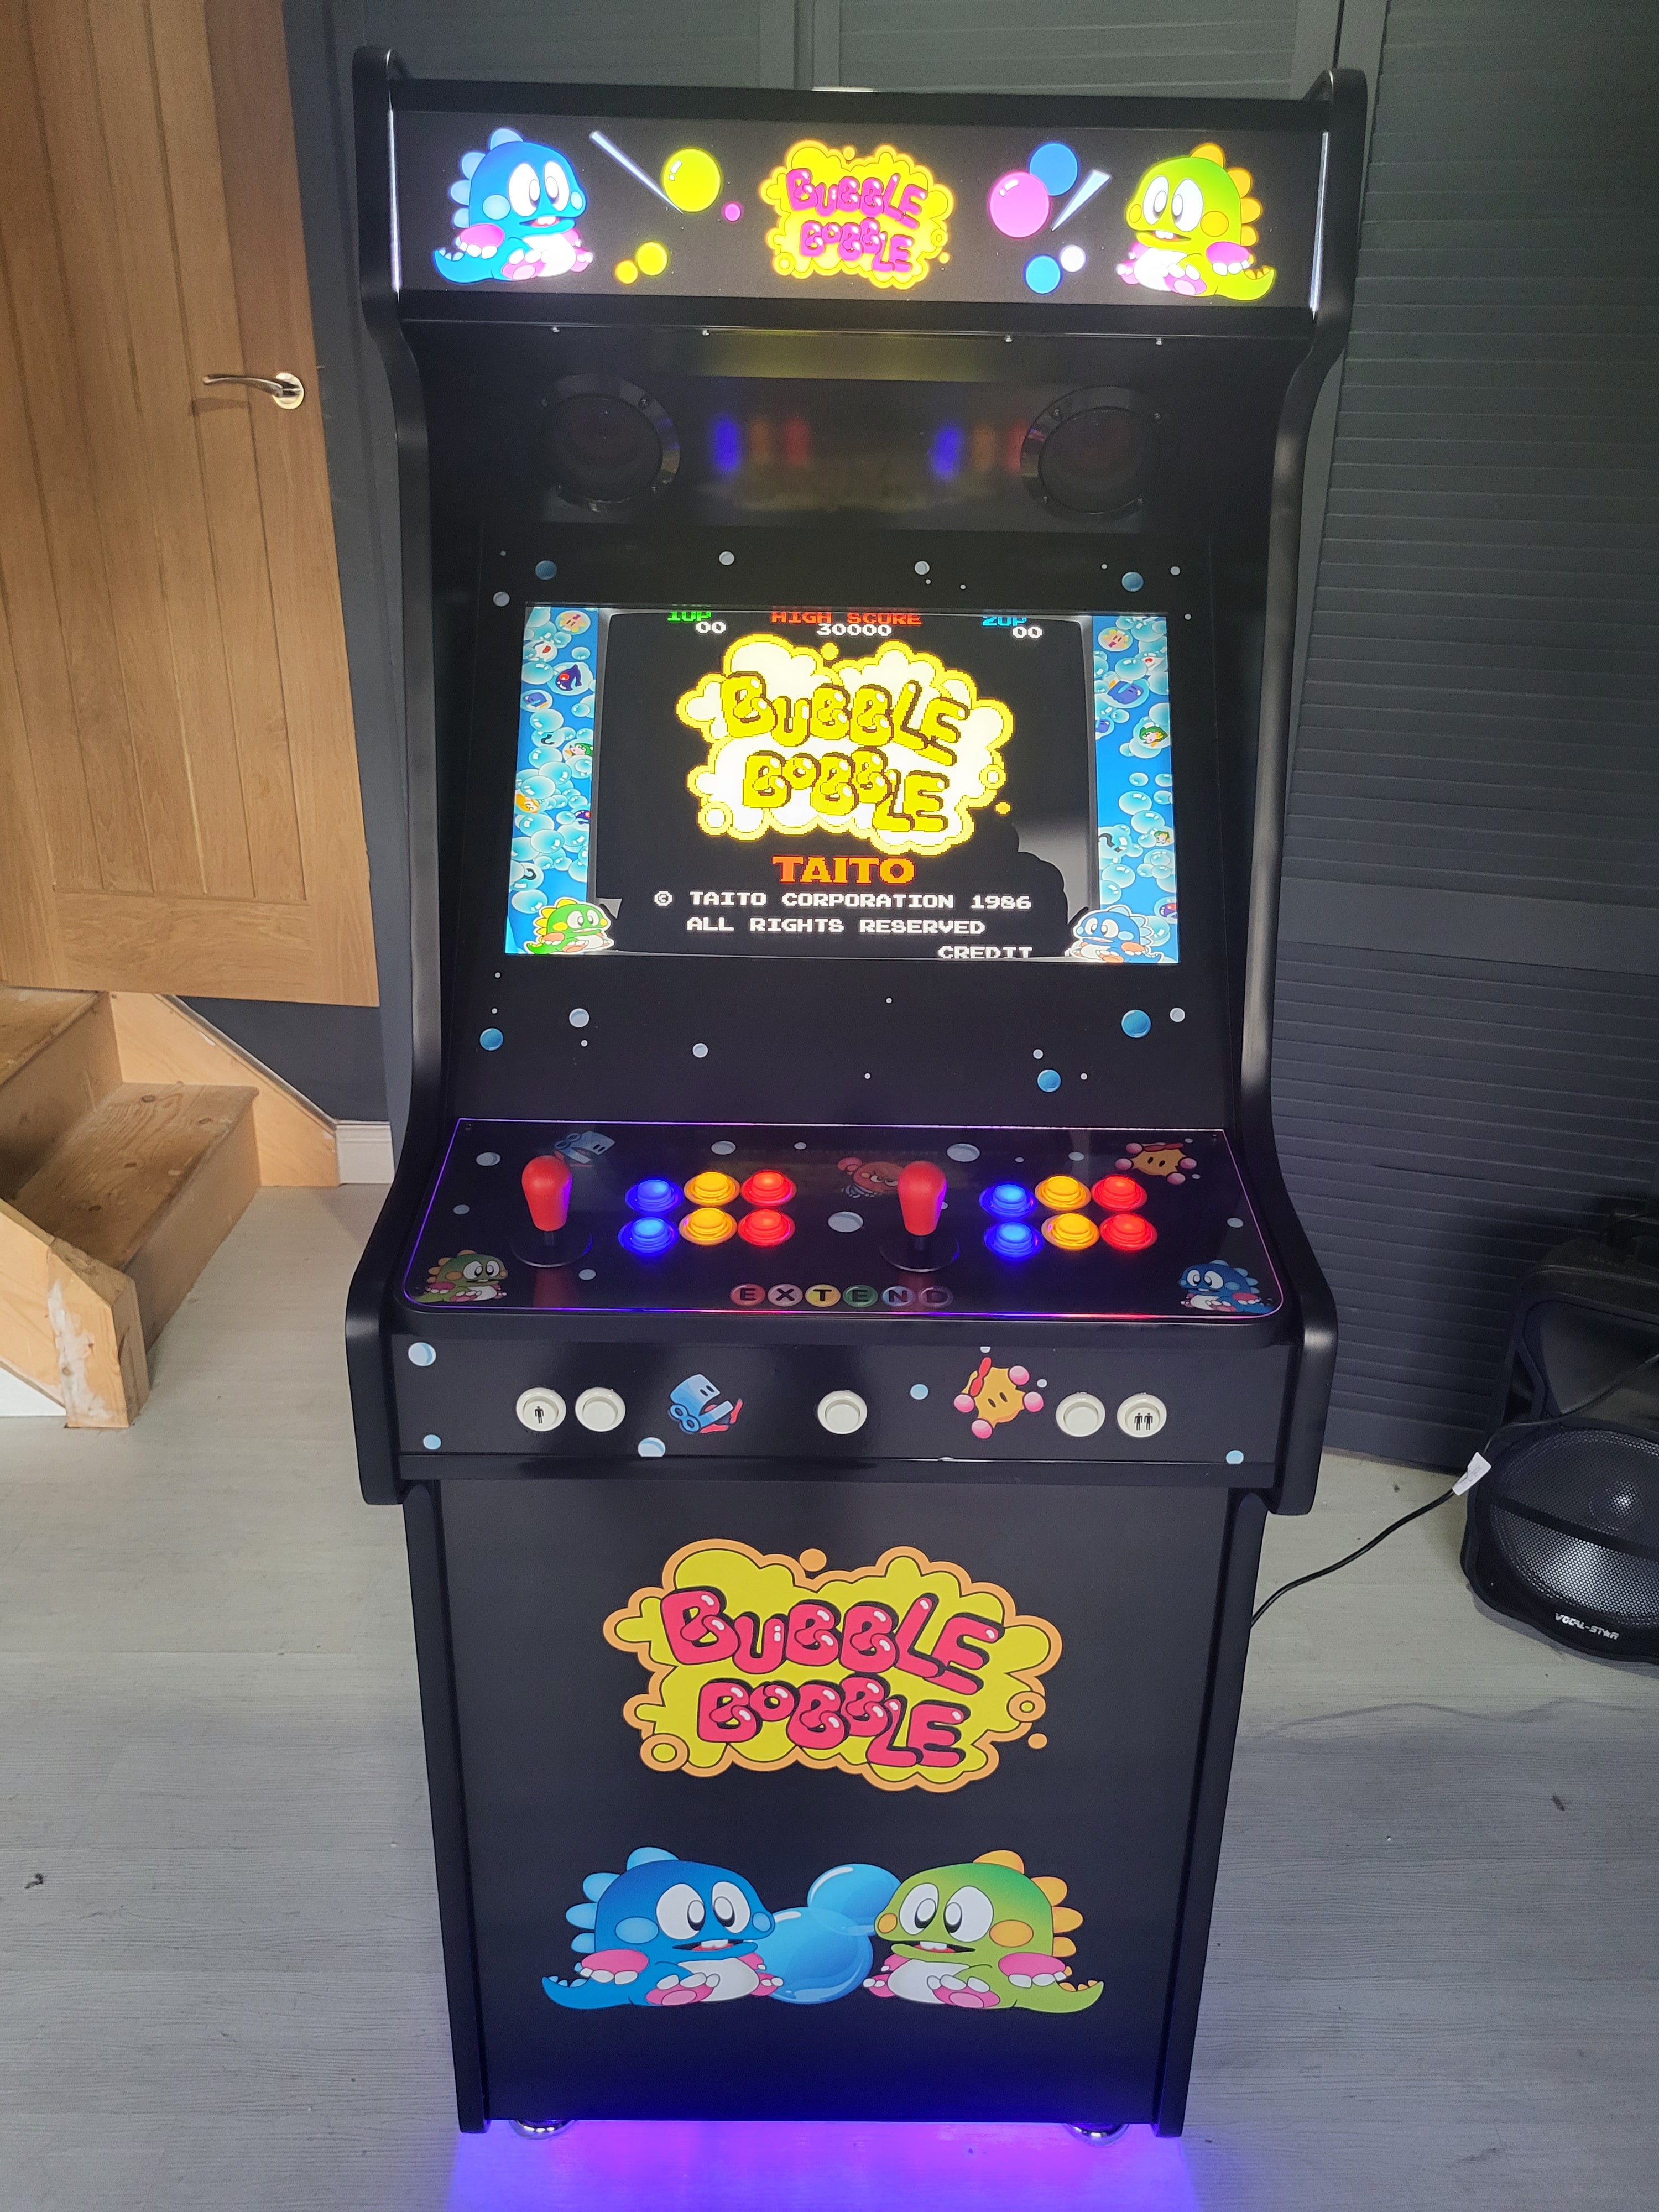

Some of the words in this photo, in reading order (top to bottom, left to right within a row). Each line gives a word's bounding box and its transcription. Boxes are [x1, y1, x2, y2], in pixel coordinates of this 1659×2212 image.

[786, 168, 928, 230] BUBBLE
[800, 217, 914, 273] BOBBLE
[667, 611, 712, 622] 1UP
[771, 611, 832, 624] HIGH
[847, 612, 922, 625] SCORE
[982, 615, 1027, 627] 2UP
[695, 620, 727, 634] 00
[817, 623, 893, 637] 30000
[1011, 625, 1043, 639] 00
[721, 671, 969, 766] BUBBLE
[743, 747, 949, 832] BOBBLE
[772, 855, 915, 884] TAITO
[689, 891, 767, 906] TAITO
[781, 893, 954, 909] CORPORATION
[971, 894, 1032, 910] 1986
[686, 916, 735, 932] ALL
[749, 917, 845, 933] RIGHTS
[859, 919, 986, 935] RESERVED
[937, 945, 1033, 959] CREDIT
[660, 1585, 1004, 1695] BUBBLE
[697, 1672, 970, 1768] BOBBLE
